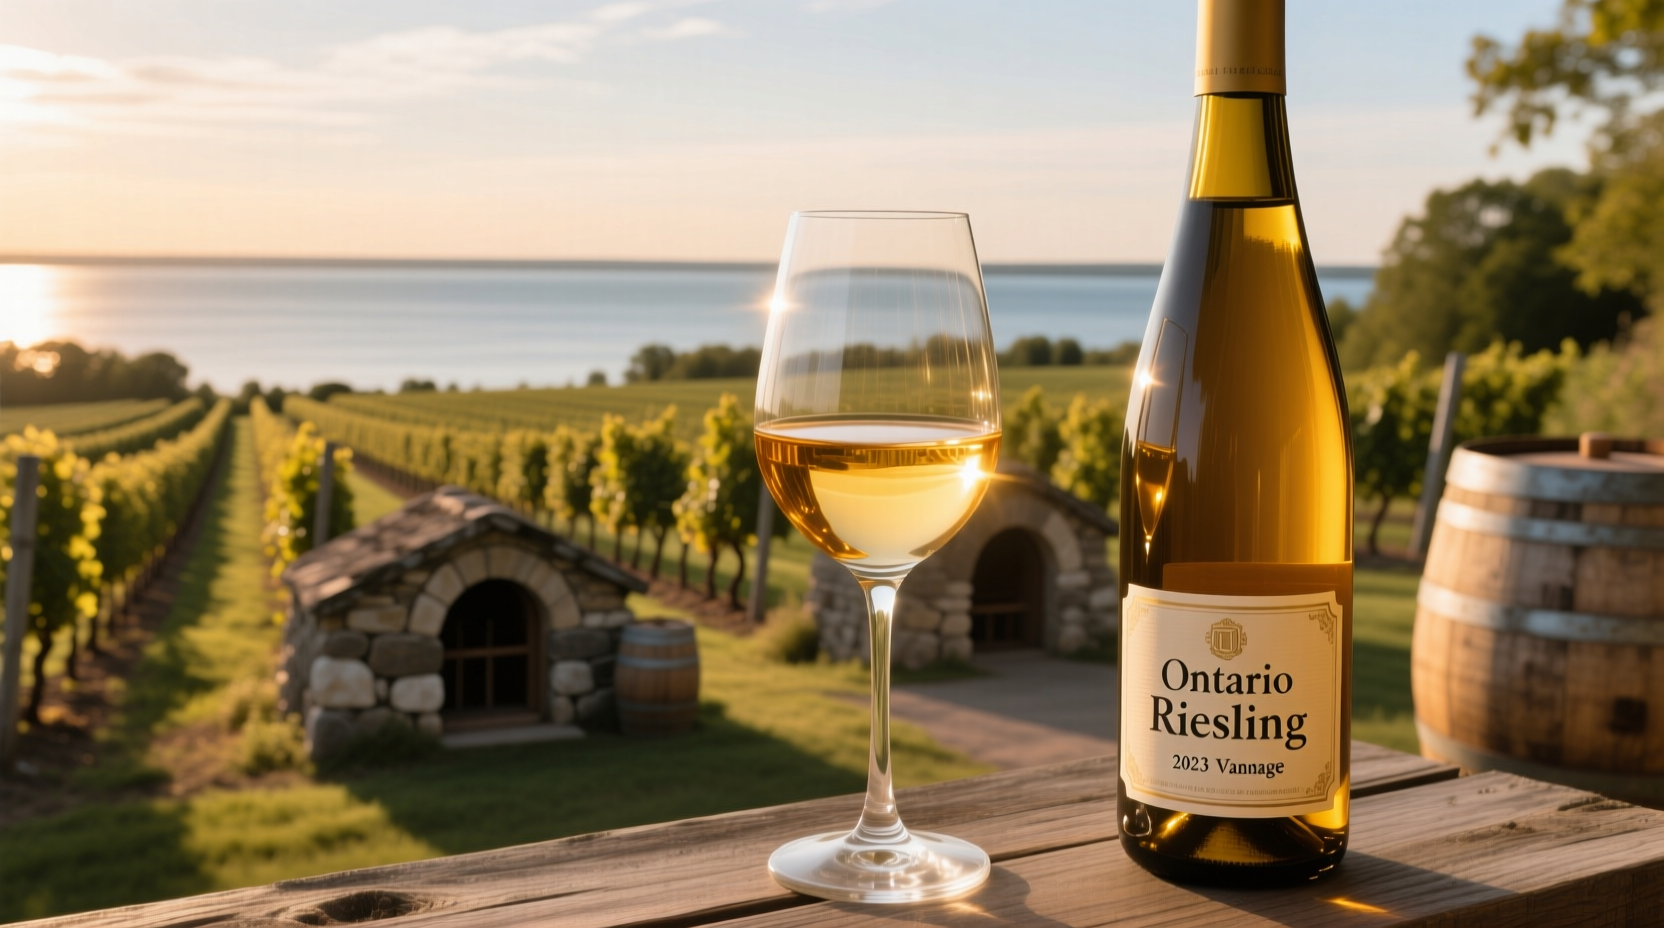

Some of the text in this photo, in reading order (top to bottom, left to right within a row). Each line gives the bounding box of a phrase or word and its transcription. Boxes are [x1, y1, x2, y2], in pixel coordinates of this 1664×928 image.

[1161, 658, 1293, 695] Ontario
[1149, 694, 1308, 751] Riesling
[1172, 754, 1285, 779] 2023 Vannage
